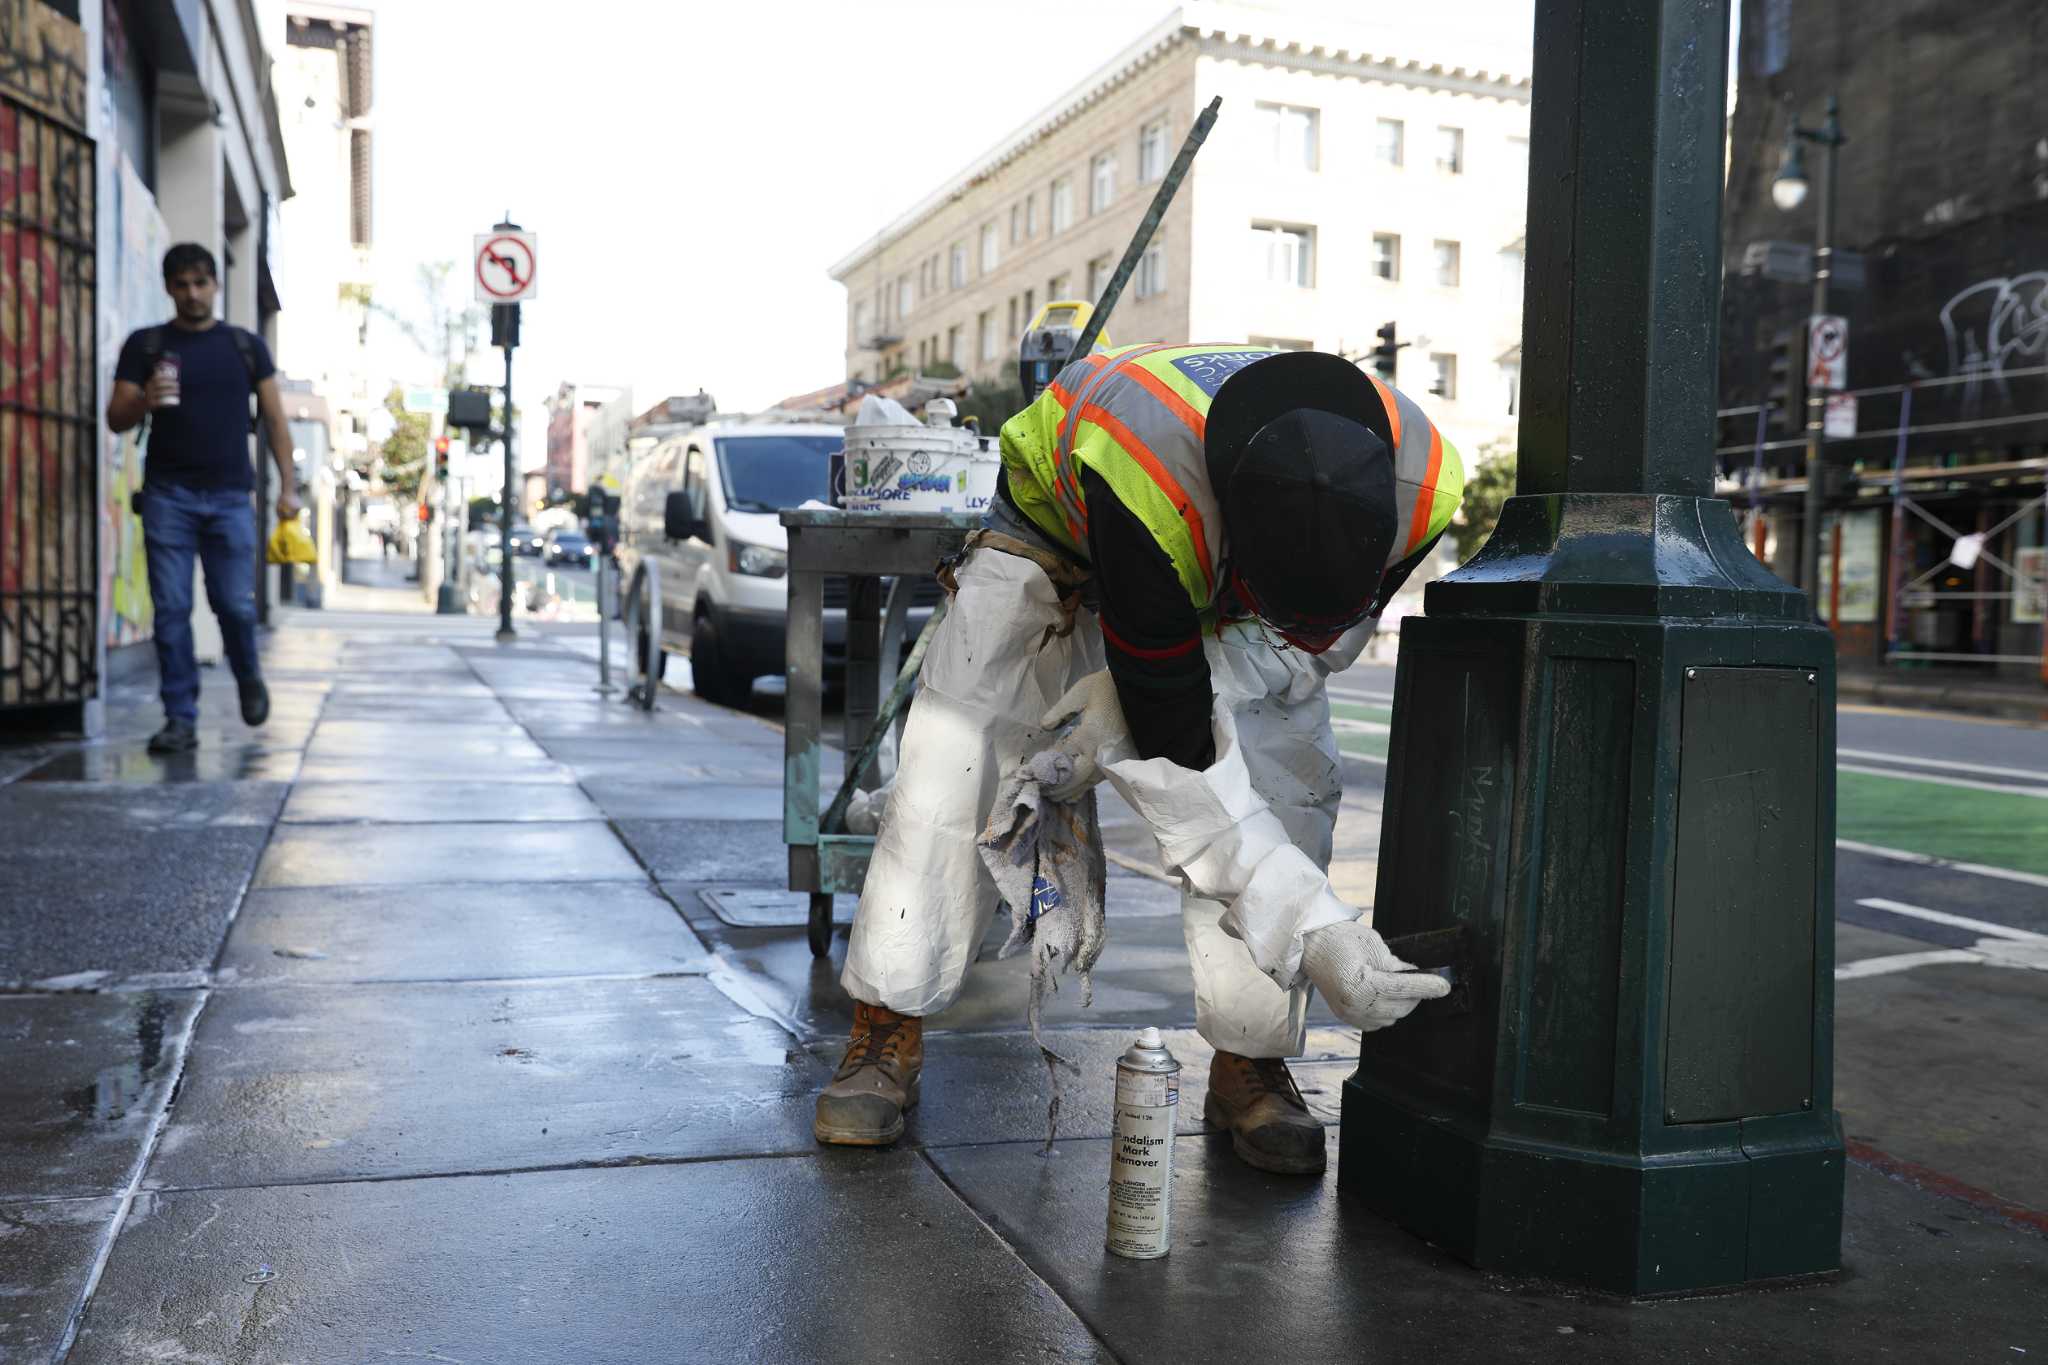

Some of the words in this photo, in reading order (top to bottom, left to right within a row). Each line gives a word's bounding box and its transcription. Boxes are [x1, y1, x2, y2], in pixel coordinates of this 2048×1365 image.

[1183, 352, 1280, 369] ORKS
[1120, 1134, 1164, 1146] ndalism
[1122, 1144, 1150, 1156] Mark
